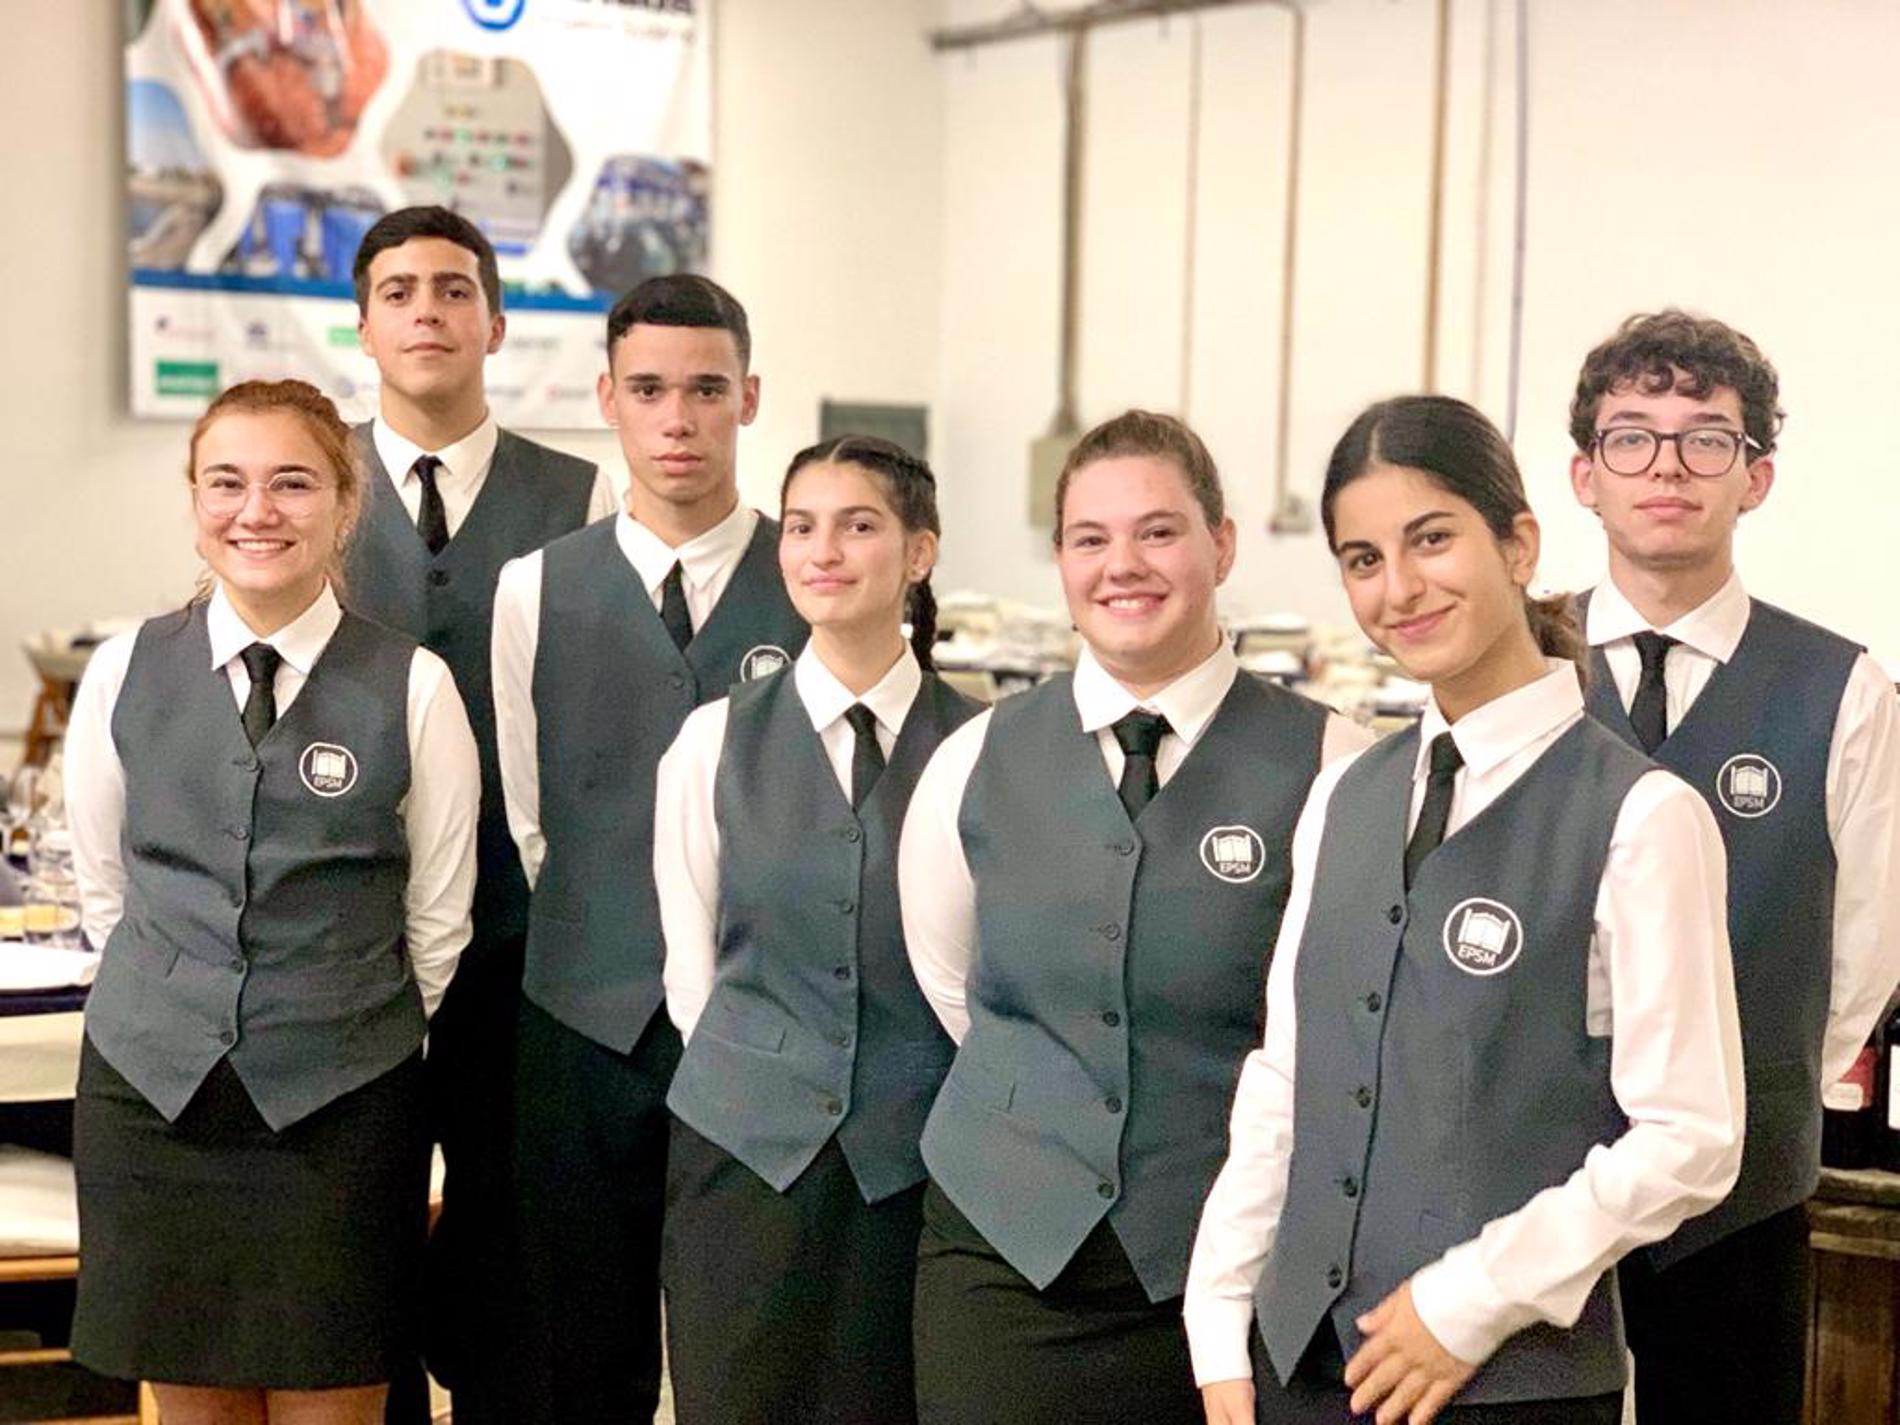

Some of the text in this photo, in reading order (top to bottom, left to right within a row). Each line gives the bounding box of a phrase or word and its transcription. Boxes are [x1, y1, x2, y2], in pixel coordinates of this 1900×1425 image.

[313, 776, 343, 789] EPSM
[1732, 796, 1766, 810] EPSM
[1219, 862, 1252, 875] EPSM
[1457, 944, 1498, 967] EPSM
